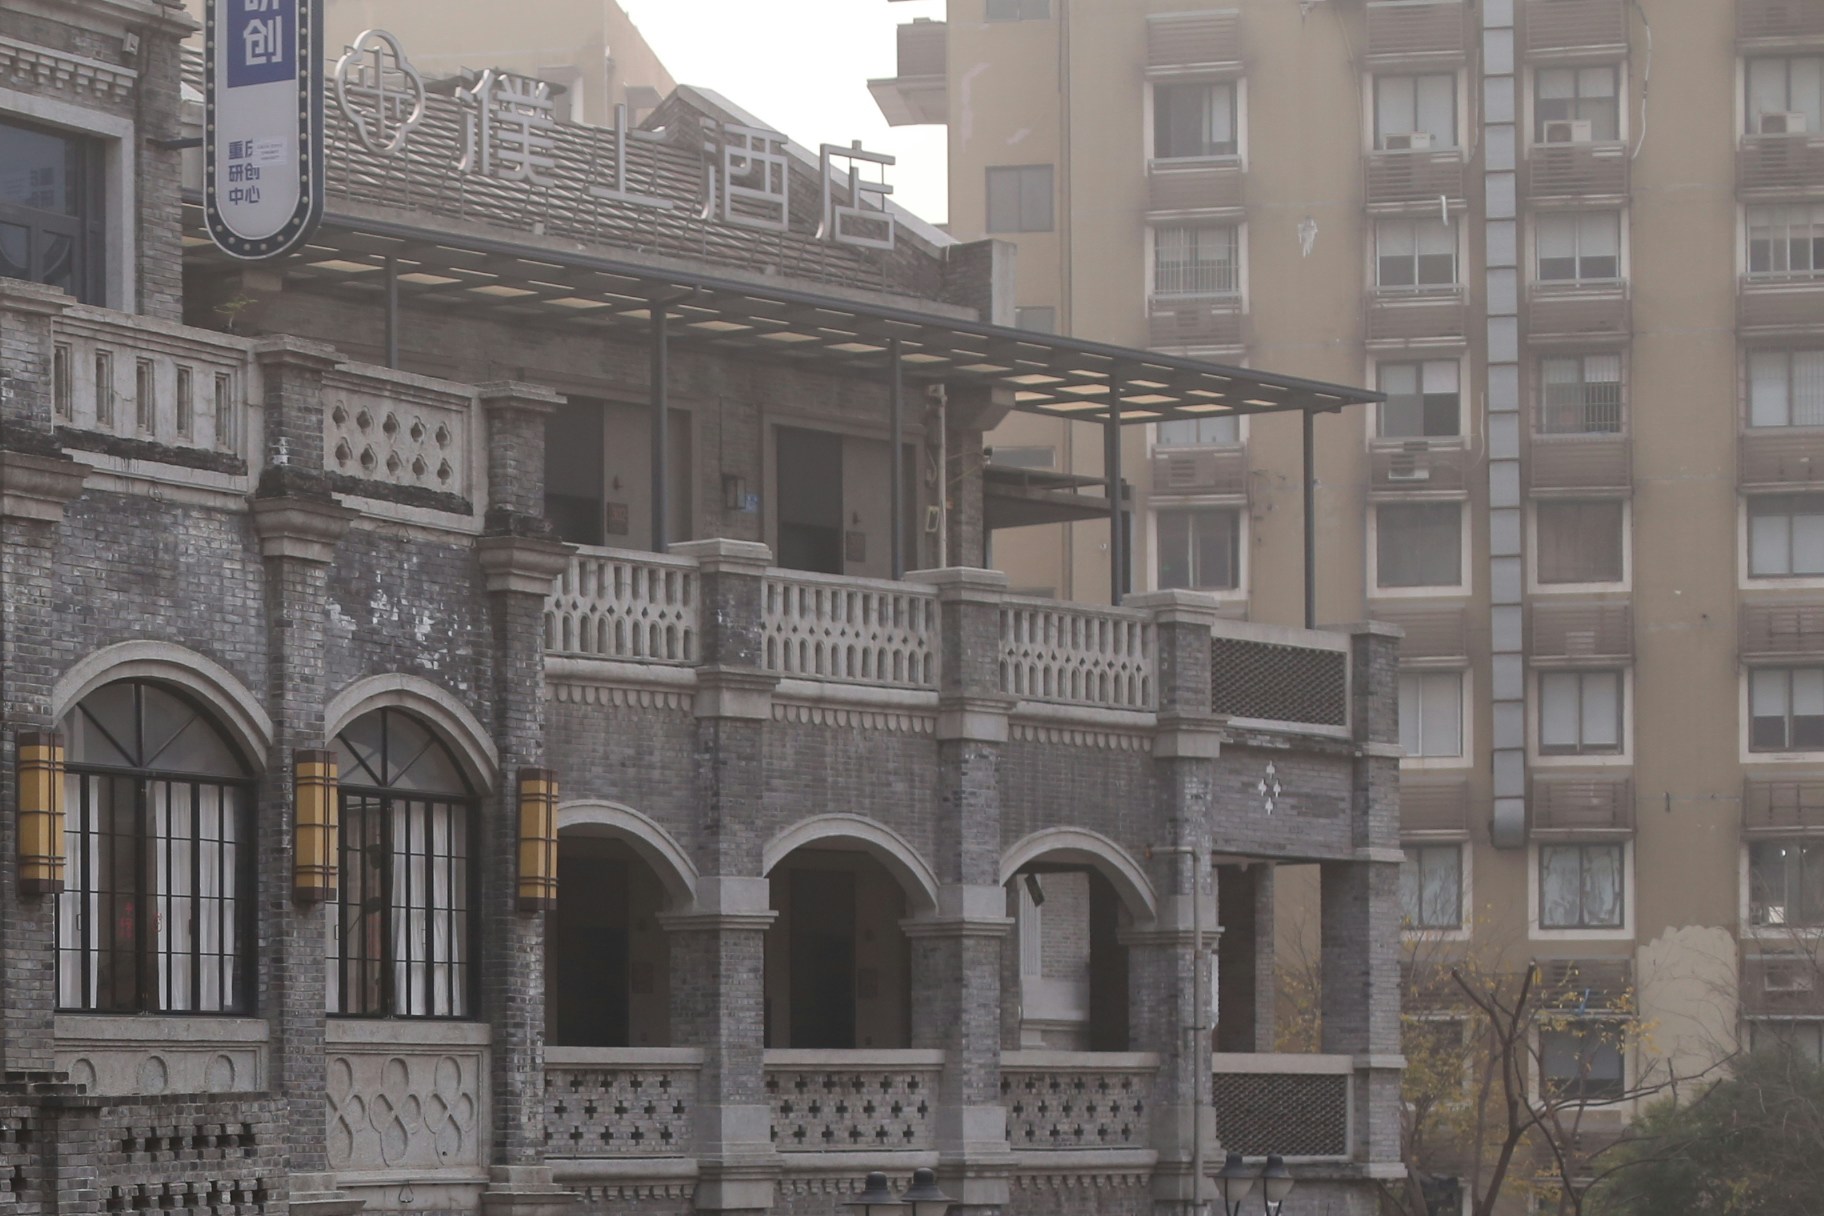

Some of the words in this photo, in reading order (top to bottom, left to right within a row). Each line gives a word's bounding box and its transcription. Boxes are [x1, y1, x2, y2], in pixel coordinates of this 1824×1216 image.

[242, 0, 283, 66] 创
[228, 164, 260, 183] 研创
[455, 66, 896, 250] 濮上酒店
[229, 186, 261, 205] 中心
